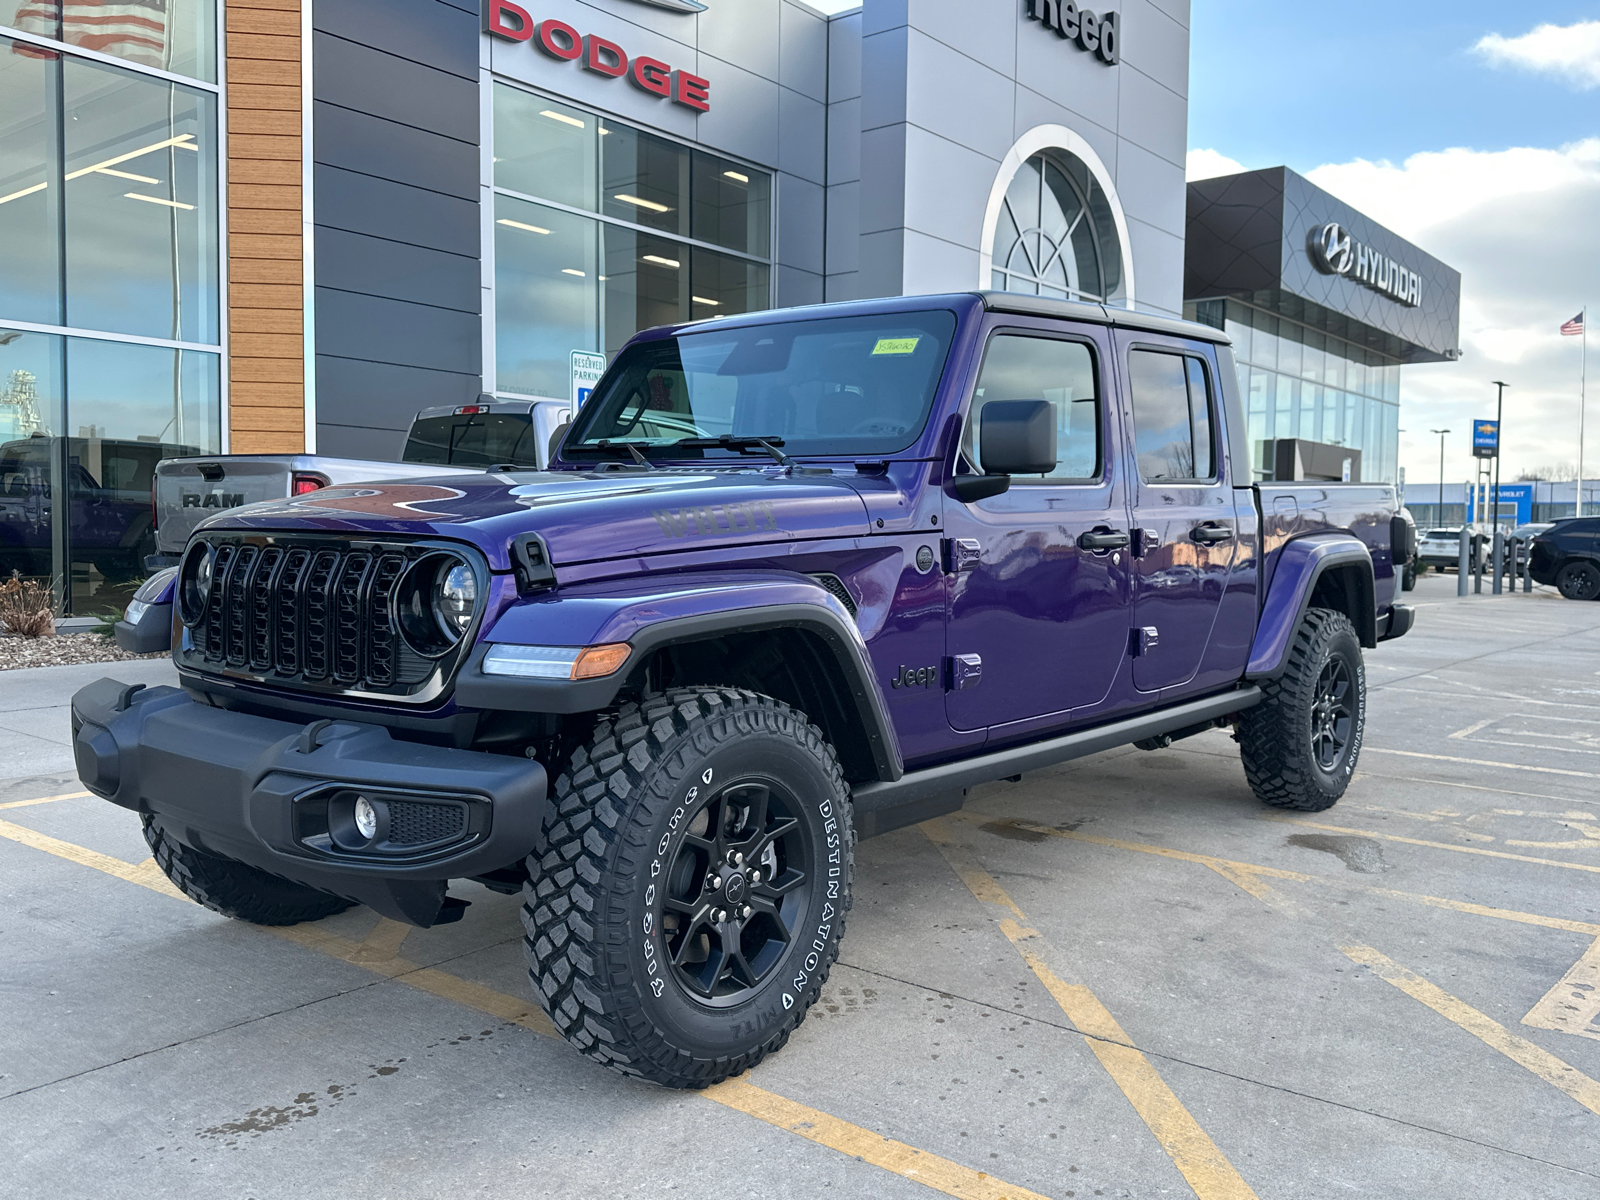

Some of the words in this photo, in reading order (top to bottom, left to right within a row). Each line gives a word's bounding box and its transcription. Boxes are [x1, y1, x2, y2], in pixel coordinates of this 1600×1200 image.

[482, 0, 710, 112] DODGE
[1356, 242, 1422, 308] HYUNDAI
[573, 357, 603, 371] RESERVED
[182, 493, 245, 508] RAM
[650, 501, 778, 539] WILLYS
[891, 664, 938, 690] Jeep
[793, 799, 840, 992] DESTINATION
